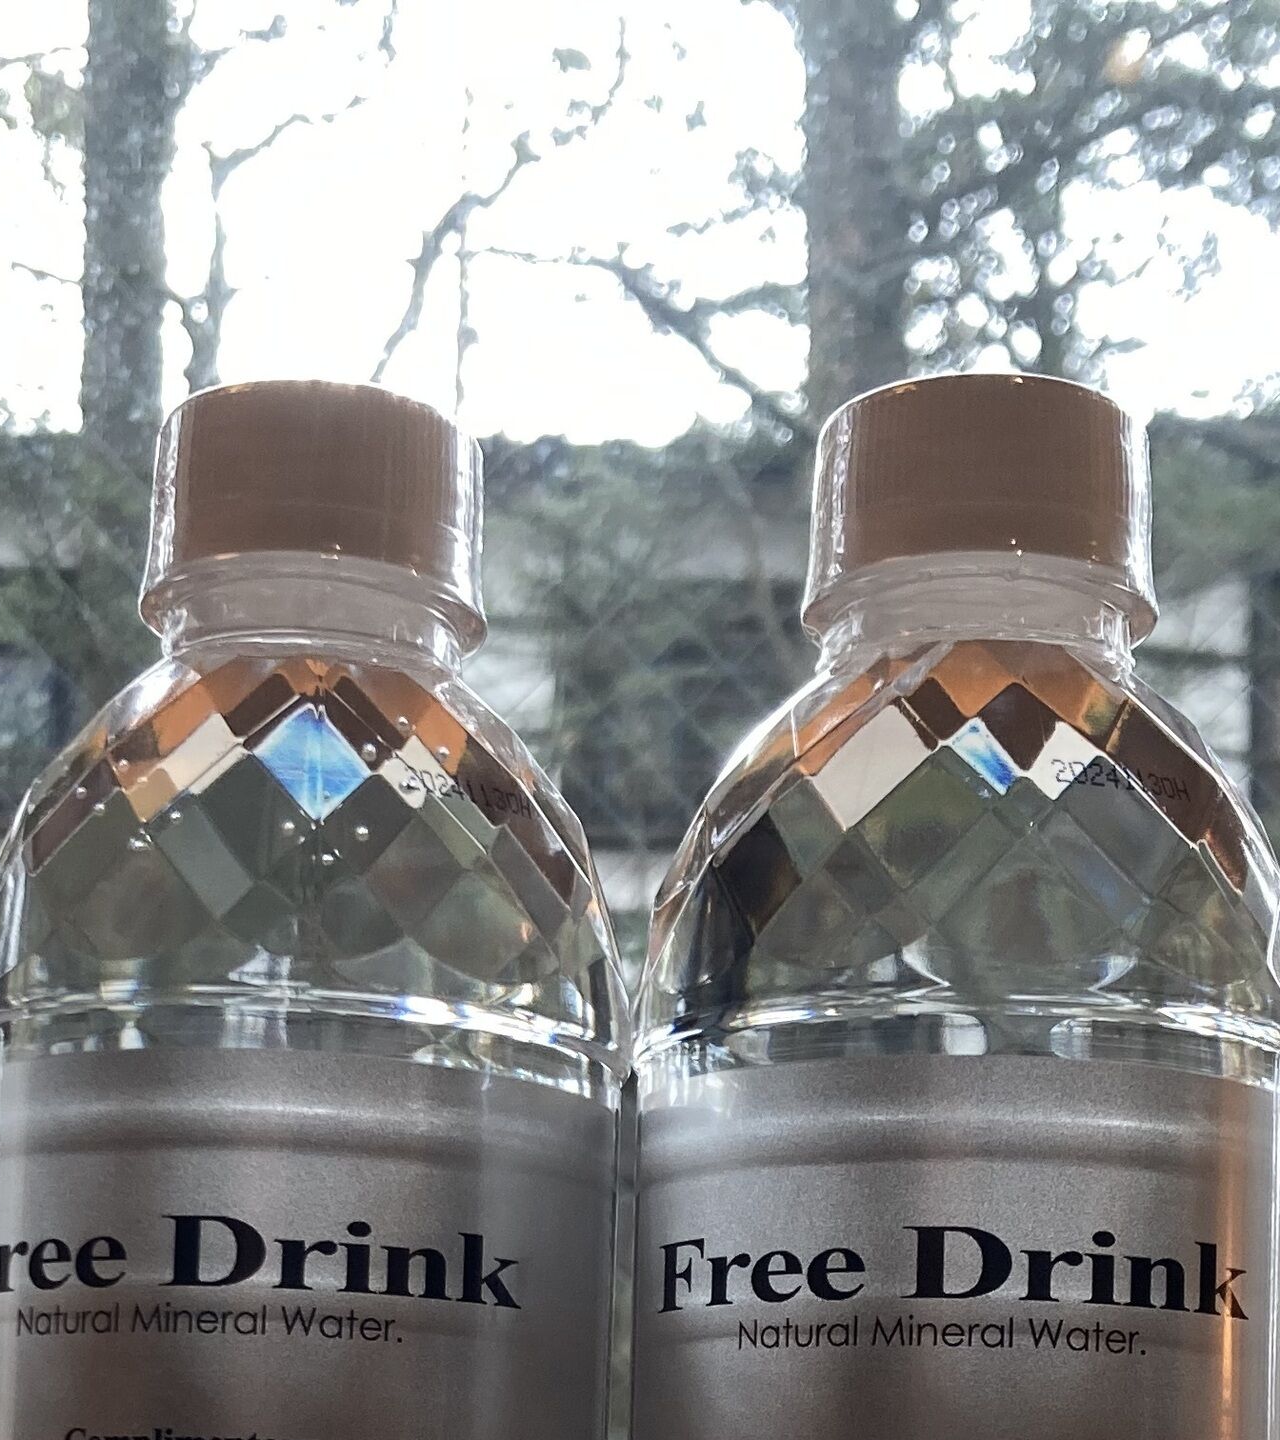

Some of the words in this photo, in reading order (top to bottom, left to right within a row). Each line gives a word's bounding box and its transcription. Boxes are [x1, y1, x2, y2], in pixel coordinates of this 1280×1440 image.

[158, 1213, 522, 1309] Drink
[658, 1238, 866, 1314] Free
[900, 1226, 1249, 1320] Drink
[16, 1302, 120, 1337] Natural
[130, 1302, 266, 1336] Mineral
[280, 1306, 404, 1344] Water.
[737, 1315, 858, 1351] Natural
[871, 1315, 1014, 1349] Mineral
[1027, 1318, 1148, 1356] Water.
